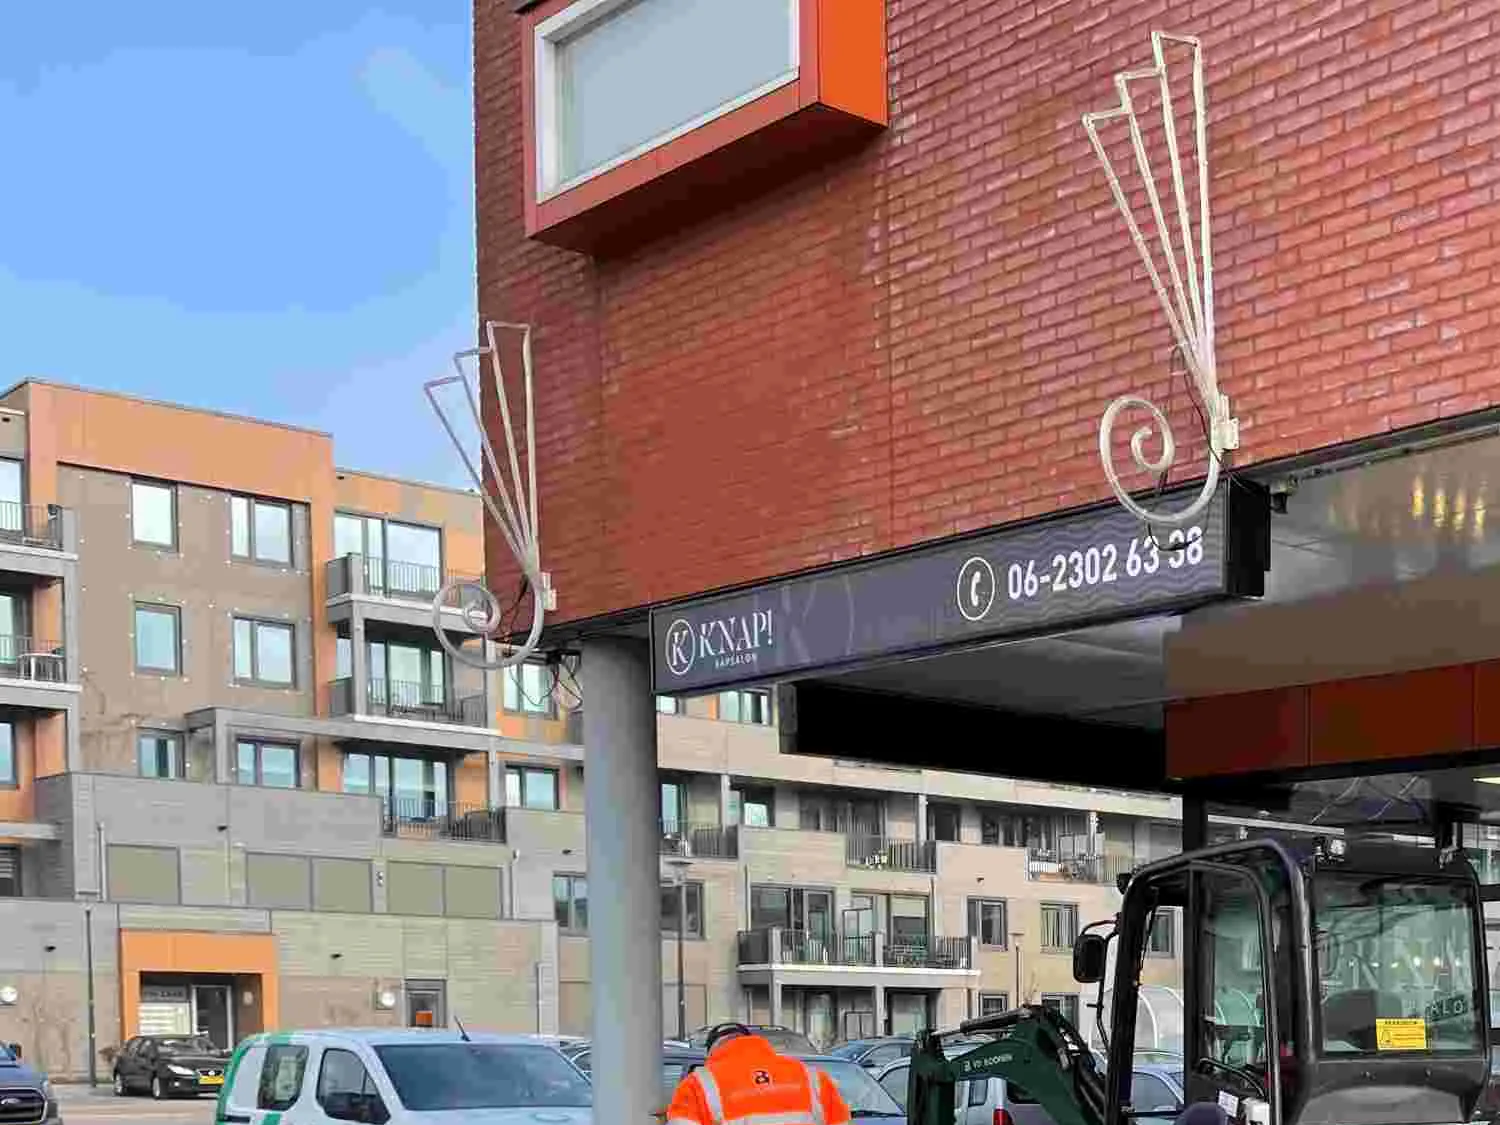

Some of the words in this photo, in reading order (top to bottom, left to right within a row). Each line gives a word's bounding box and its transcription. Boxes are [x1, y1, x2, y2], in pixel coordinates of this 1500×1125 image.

[1007, 543, 1117, 600] 06-2302
[1126, 535, 1161, 577] 63
[1168, 525, 1203, 569] 38
[699, 609, 773, 658] KNAP!
